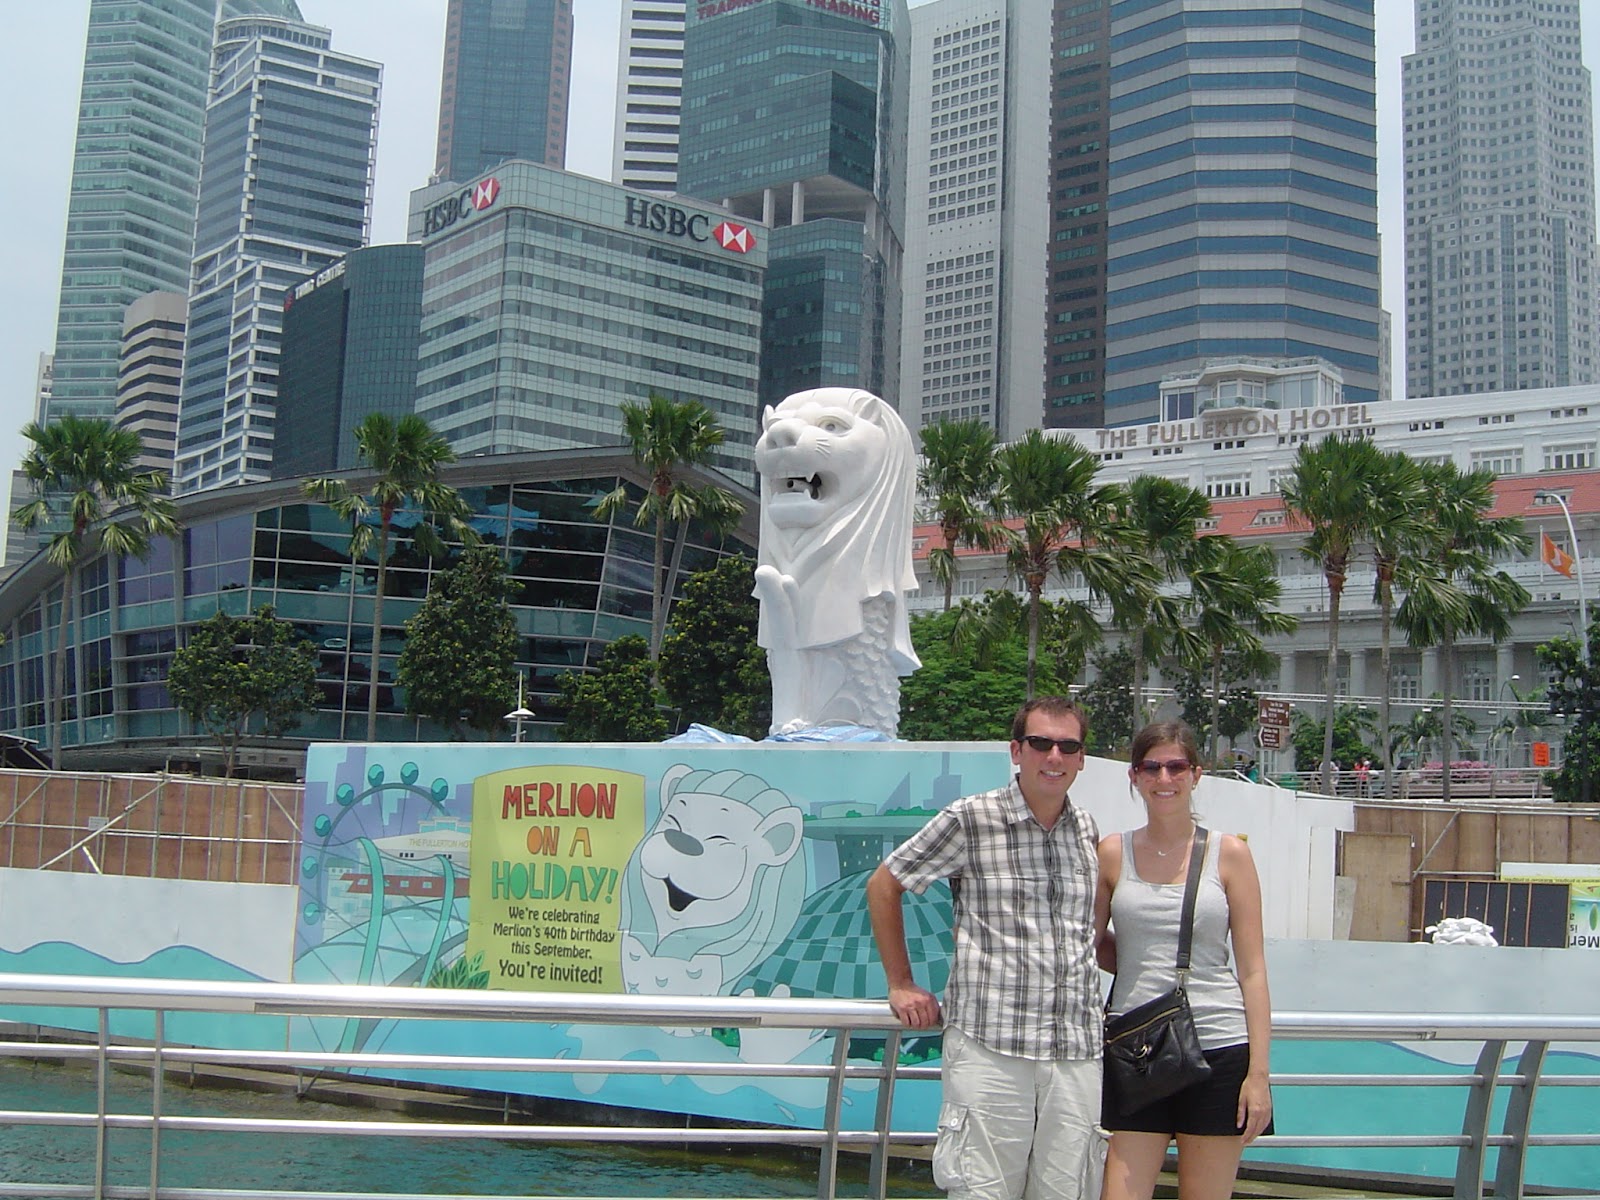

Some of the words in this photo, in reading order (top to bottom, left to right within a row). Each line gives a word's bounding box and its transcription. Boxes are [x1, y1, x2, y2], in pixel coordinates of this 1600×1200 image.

[696, 0, 763, 20] TRADI
[422, 188, 472, 237] HSBC
[624, 195, 710, 242] HSBC
[1096, 428, 1137, 449] THE
[1147, 413, 1279, 444] FULLERTON
[1290, 404, 1373, 431] HOTEL
[502, 782, 618, 820] MERLION
[526, 825, 560, 857] ON
[568, 827, 593, 858] A
[491, 861, 619, 905] HOLIDAY!
[508, 906, 540, 920] We're
[542, 908, 600, 925] celebrating
[493, 922, 541, 938] Merlion's
[544, 925, 567, 940] 40th
[570, 927, 616, 943] birthday
[511, 941, 531, 955] this
[533, 942, 593, 960] September.
[499, 959, 546, 980] You're
[550, 962, 603, 985] invited!
